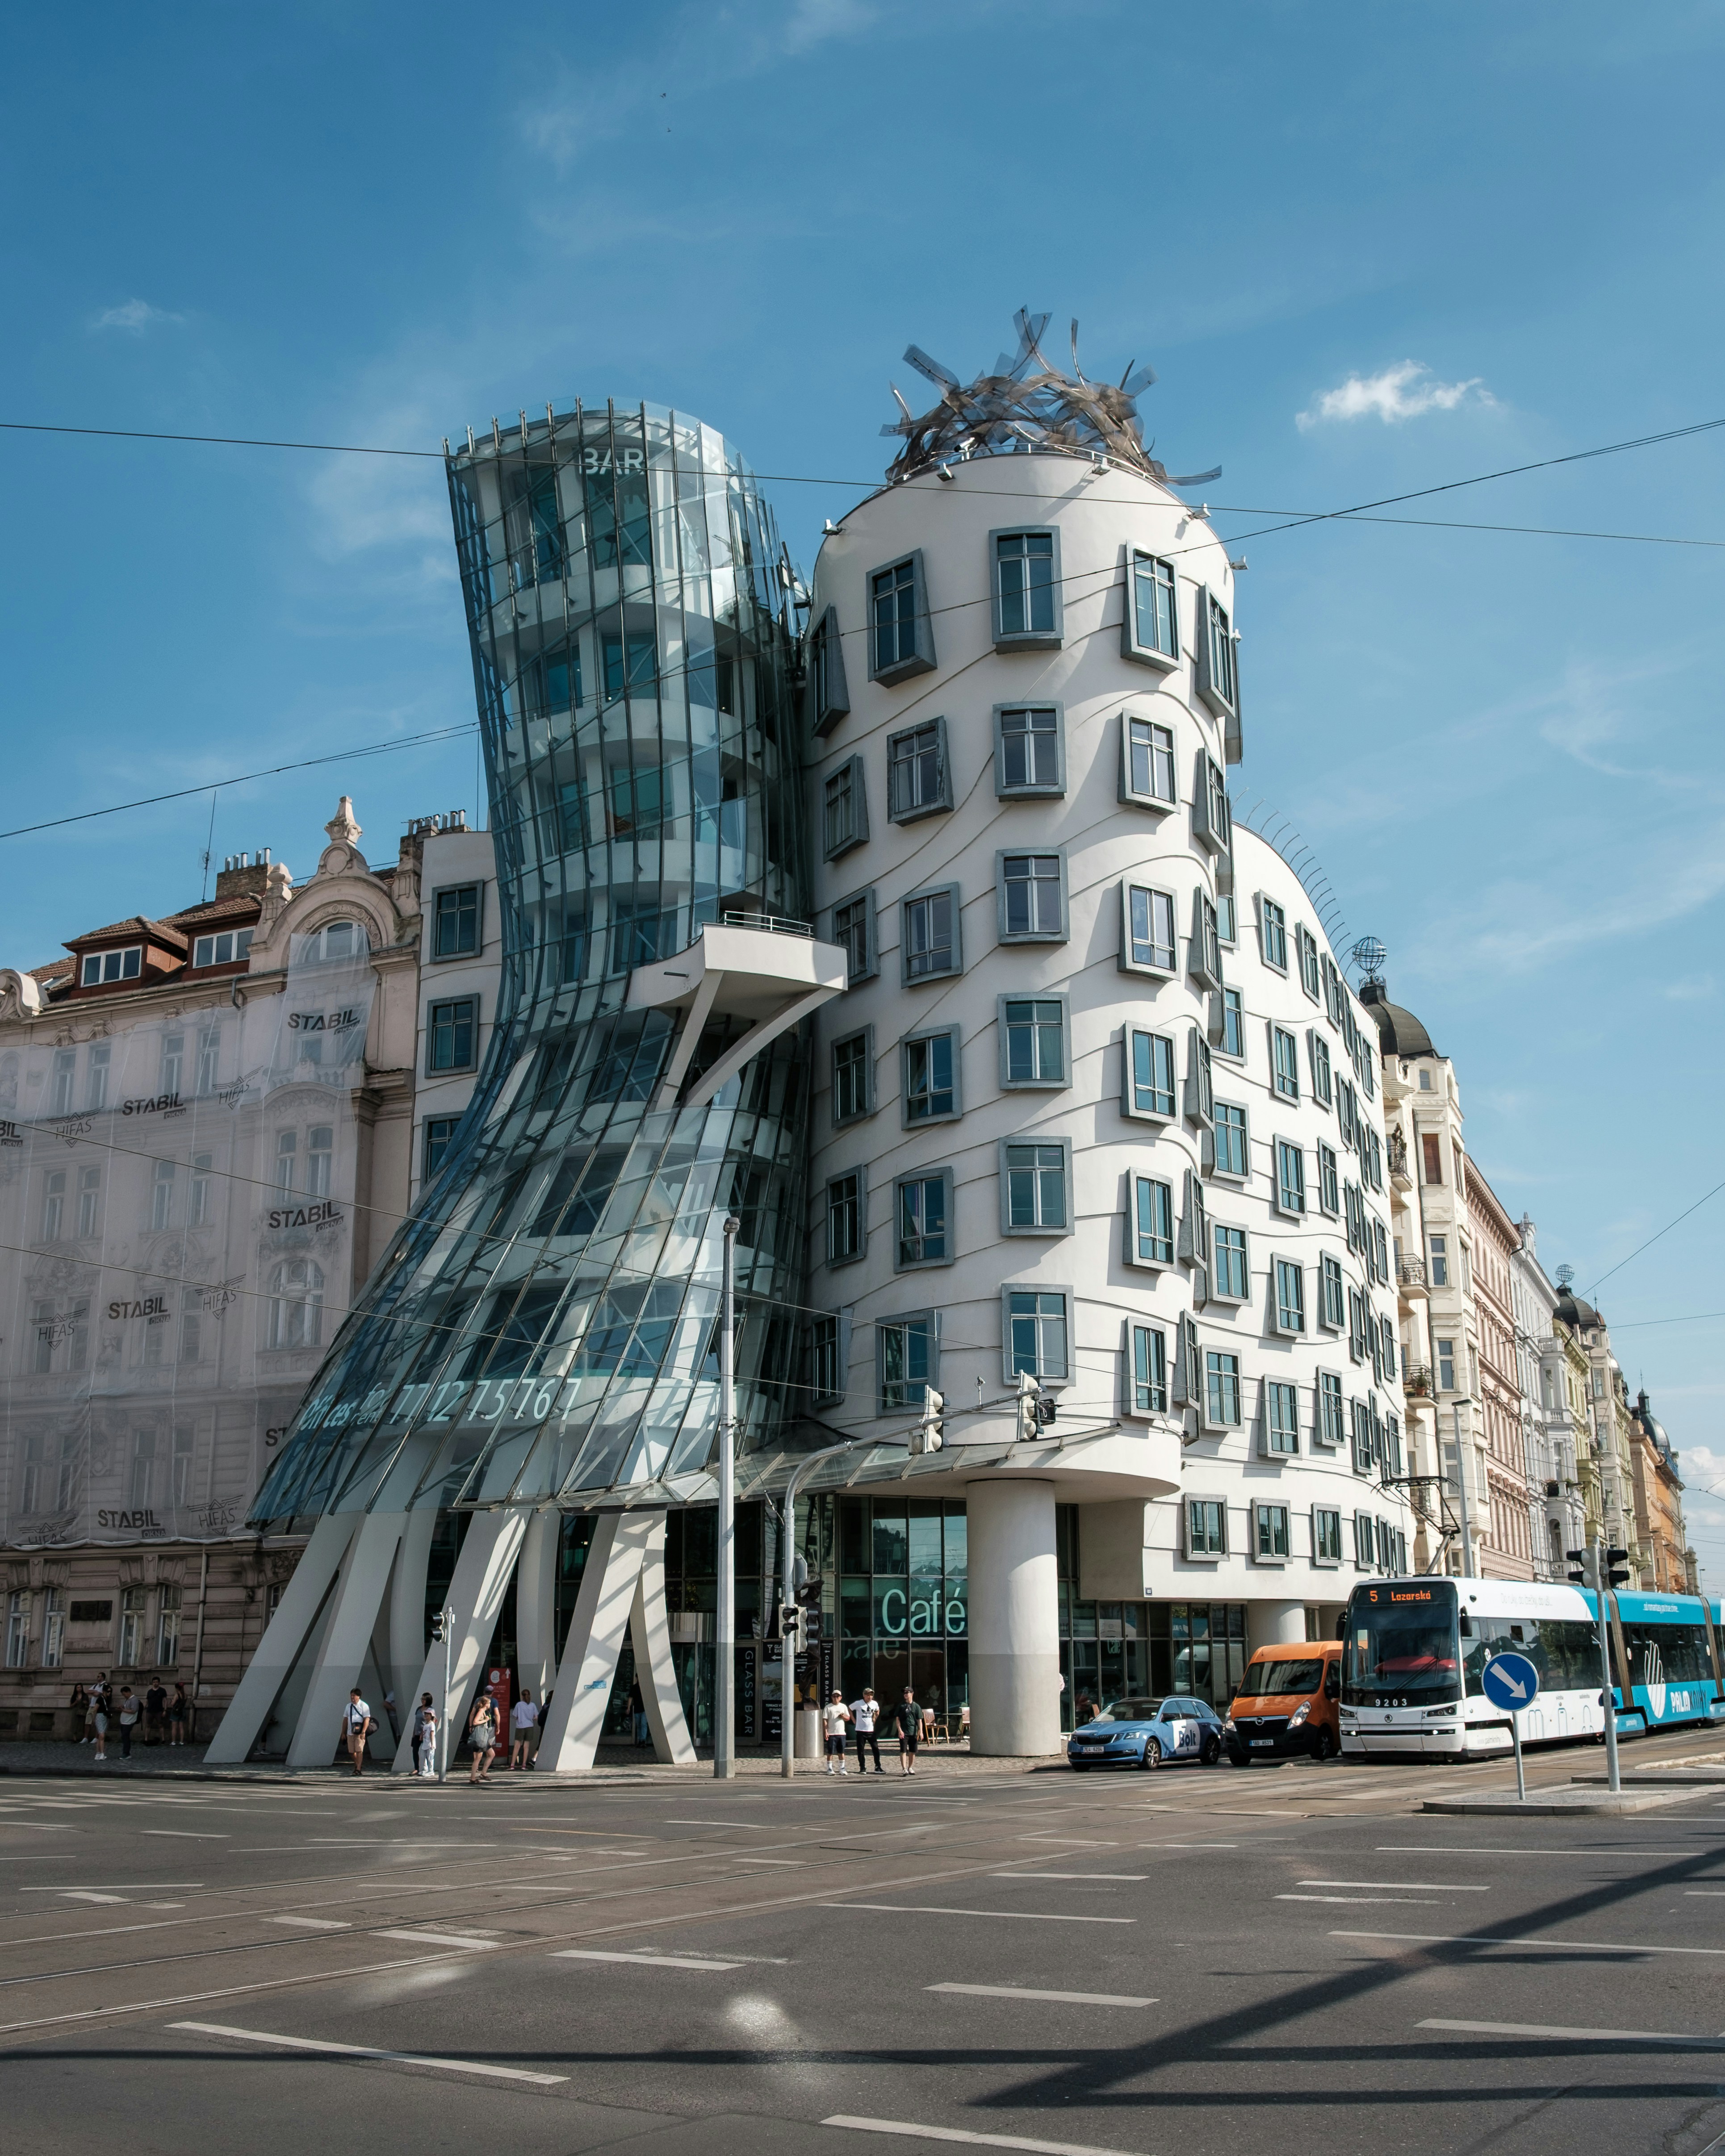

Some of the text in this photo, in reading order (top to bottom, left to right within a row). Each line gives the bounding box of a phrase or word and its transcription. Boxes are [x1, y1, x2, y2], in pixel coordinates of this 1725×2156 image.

[579, 447, 645, 475] BAR
[288, 1009, 358, 1030] STABIL
[219, 1079, 251, 1104] HIFAS
[122, 1092, 184, 1116] STABIL
[165, 1109, 186, 1119] OKNA
[3, 1140, 22, 1148] OKNA
[269, 1201, 340, 1229] STABIL
[318, 1218, 343, 1232] OKNA
[109, 1297, 168, 1320] STABIL
[38, 1321, 75, 1341] HIFAS
[297, 1394, 357, 1431] Offces
[97, 1509, 161, 1529] STABIL
[199, 1508, 235, 1529] HIFAS
[1369, 1589, 1432, 1602] 5 Lazarská
[882, 1587, 965, 1634] Café
[745, 1651, 754, 1734] GLASS BAR
[1178, 1729, 1196, 1748] Bolt
